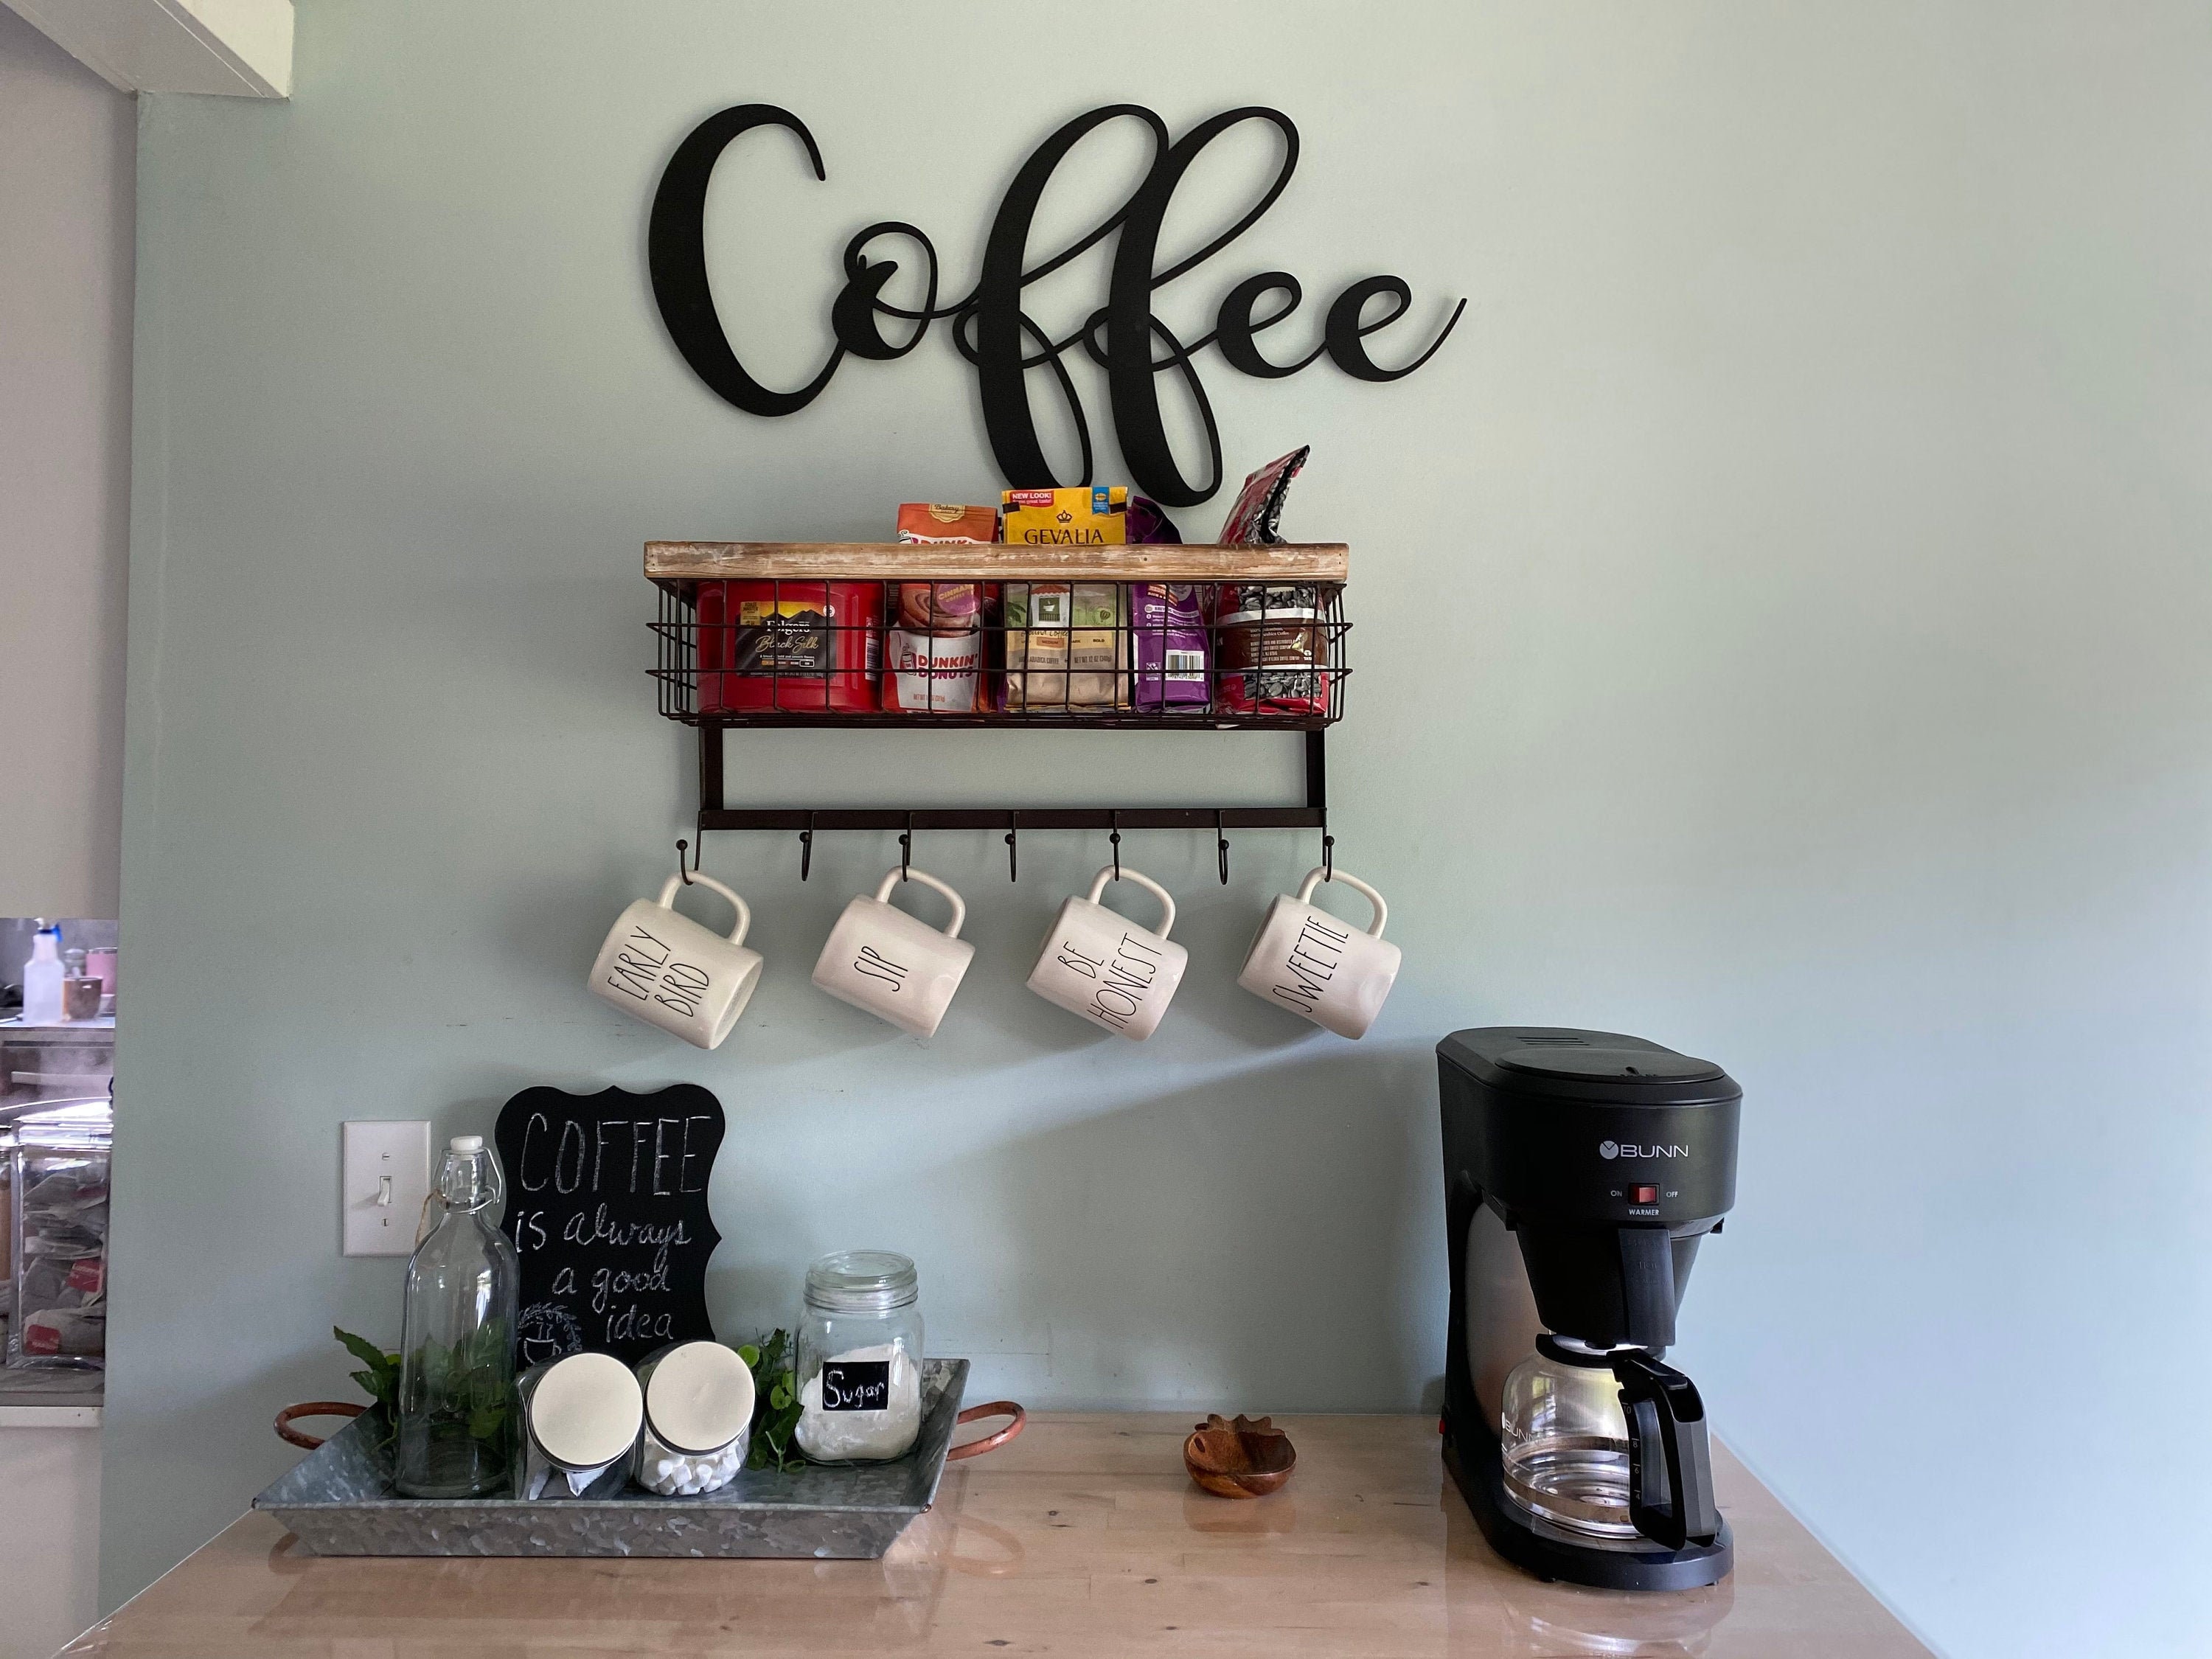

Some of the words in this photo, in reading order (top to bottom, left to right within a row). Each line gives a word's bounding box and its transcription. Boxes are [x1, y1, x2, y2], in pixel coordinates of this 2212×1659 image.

[648, 103, 1467, 507] Coffee
[1024, 529, 1104, 545] GEVALIA
[766, 620, 810, 635] Flgers
[792, 636, 819, 653] Silk
[918, 653, 978, 669] DUNKIN'
[607, 925, 671, 1001] EARLY
[853, 946, 908, 992] SIP
[1057, 941, 1105, 979] BE
[1086, 932, 1162, 1030] HONEST
[1272, 915, 1349, 1013] SWEETIE
[654, 962, 709, 1018] BIRD
[519, 1112, 712, 1196] COFFEE
[1620, 1144, 1688, 1158] BUNN
[515, 1210, 547, 1253] is
[563, 1202, 692, 1272] always
[552, 1266, 577, 1295] a
[591, 1265, 672, 1313] good
[606, 1304, 675, 1343] idea
[824, 1368, 886, 1409] Sugar
[1623, 1405, 1632, 1414] 10
